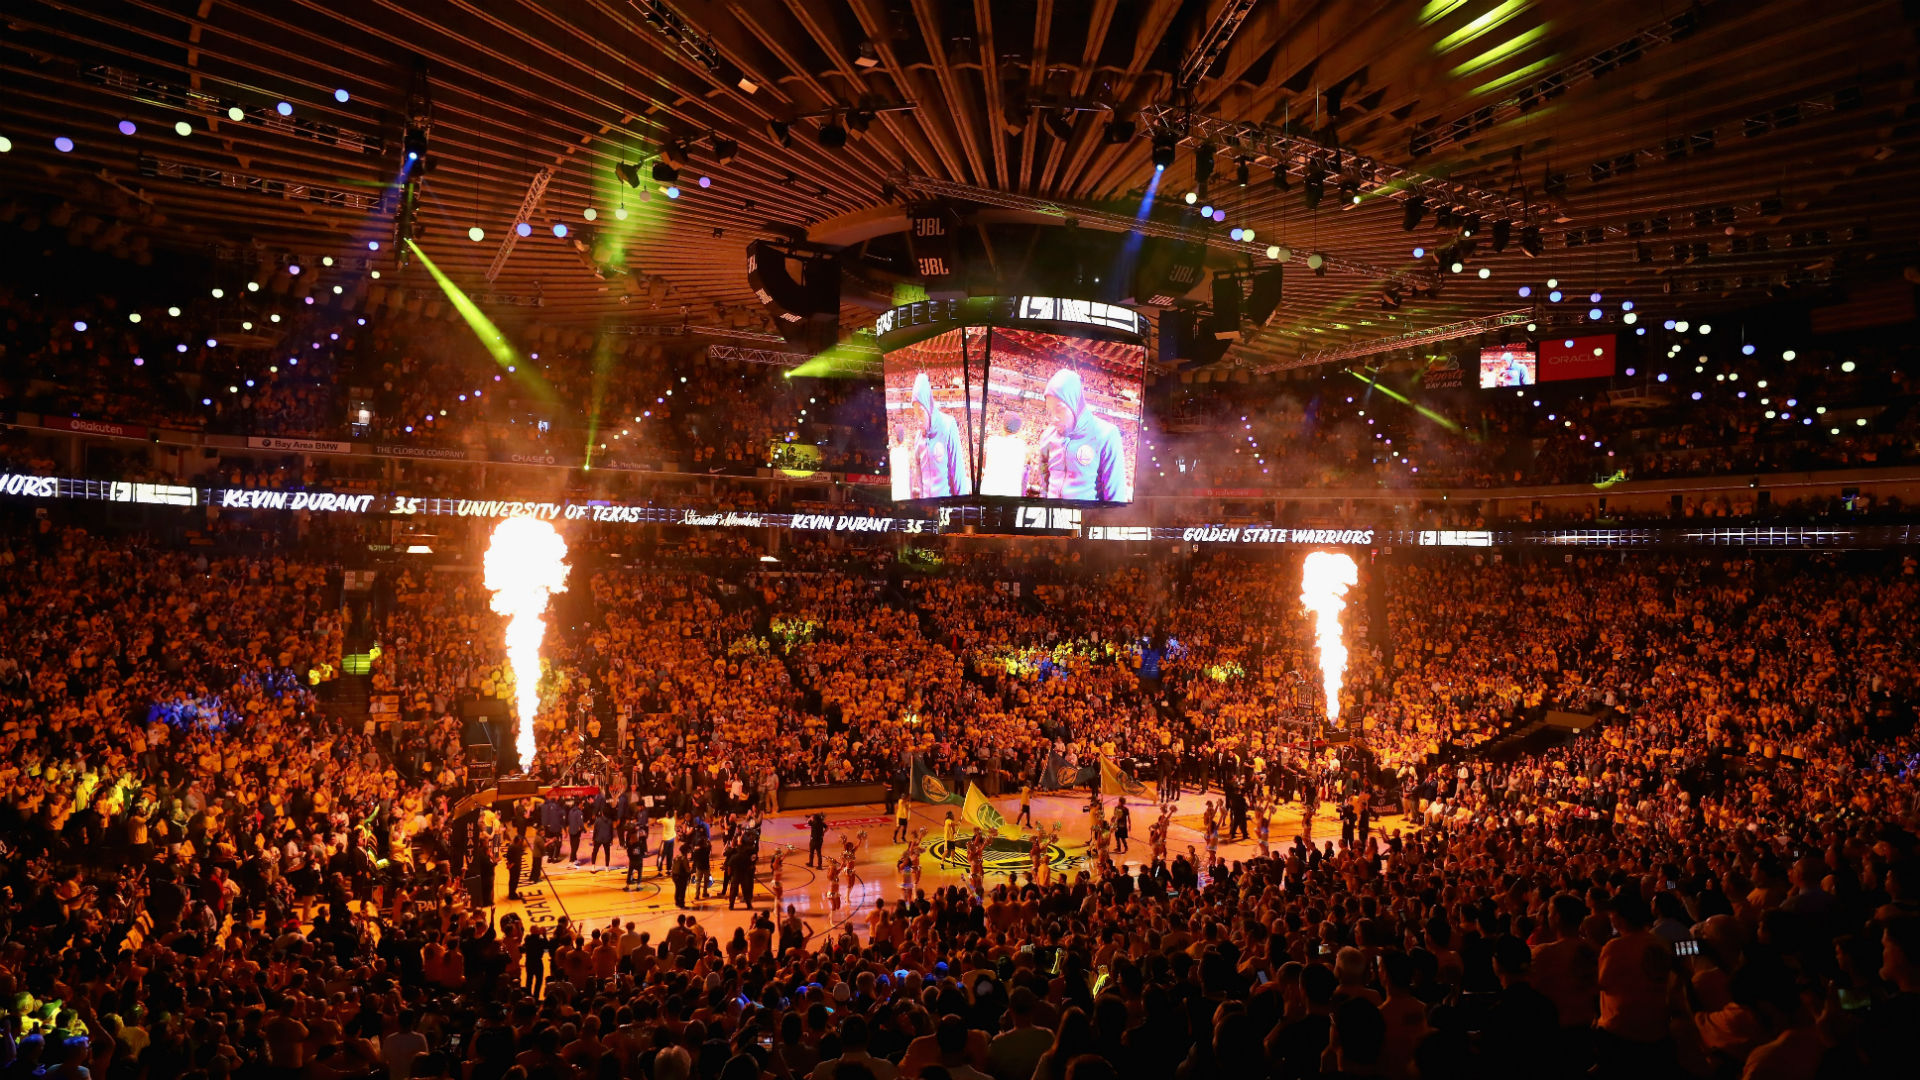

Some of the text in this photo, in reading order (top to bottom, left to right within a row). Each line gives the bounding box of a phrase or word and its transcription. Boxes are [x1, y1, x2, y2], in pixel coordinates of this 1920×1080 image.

[915, 217, 945, 237] JBL
[918, 257, 950, 276] JBL
[1169, 264, 1195, 284] JBL
[1148, 294, 1176, 306] JBL
[80, 422, 123, 435] Rakuten
[275, 440, 338, 450] Bay Area BMW
[376, 446, 465, 458] THE CLOROX COMPANY
[511, 454, 546, 464] CHASE
[223, 489, 375, 513] KEVIN DURANT
[389, 496, 421, 515] 35
[457, 499, 642, 523] UNIVERSITY OF TEXAS
[938, 506, 953, 527] 35
[790, 514, 893, 533] KEVIN DURANT
[903, 518, 924, 534] 35
[1183, 527, 1374, 545] GOLDEN STATE WARRIORS
